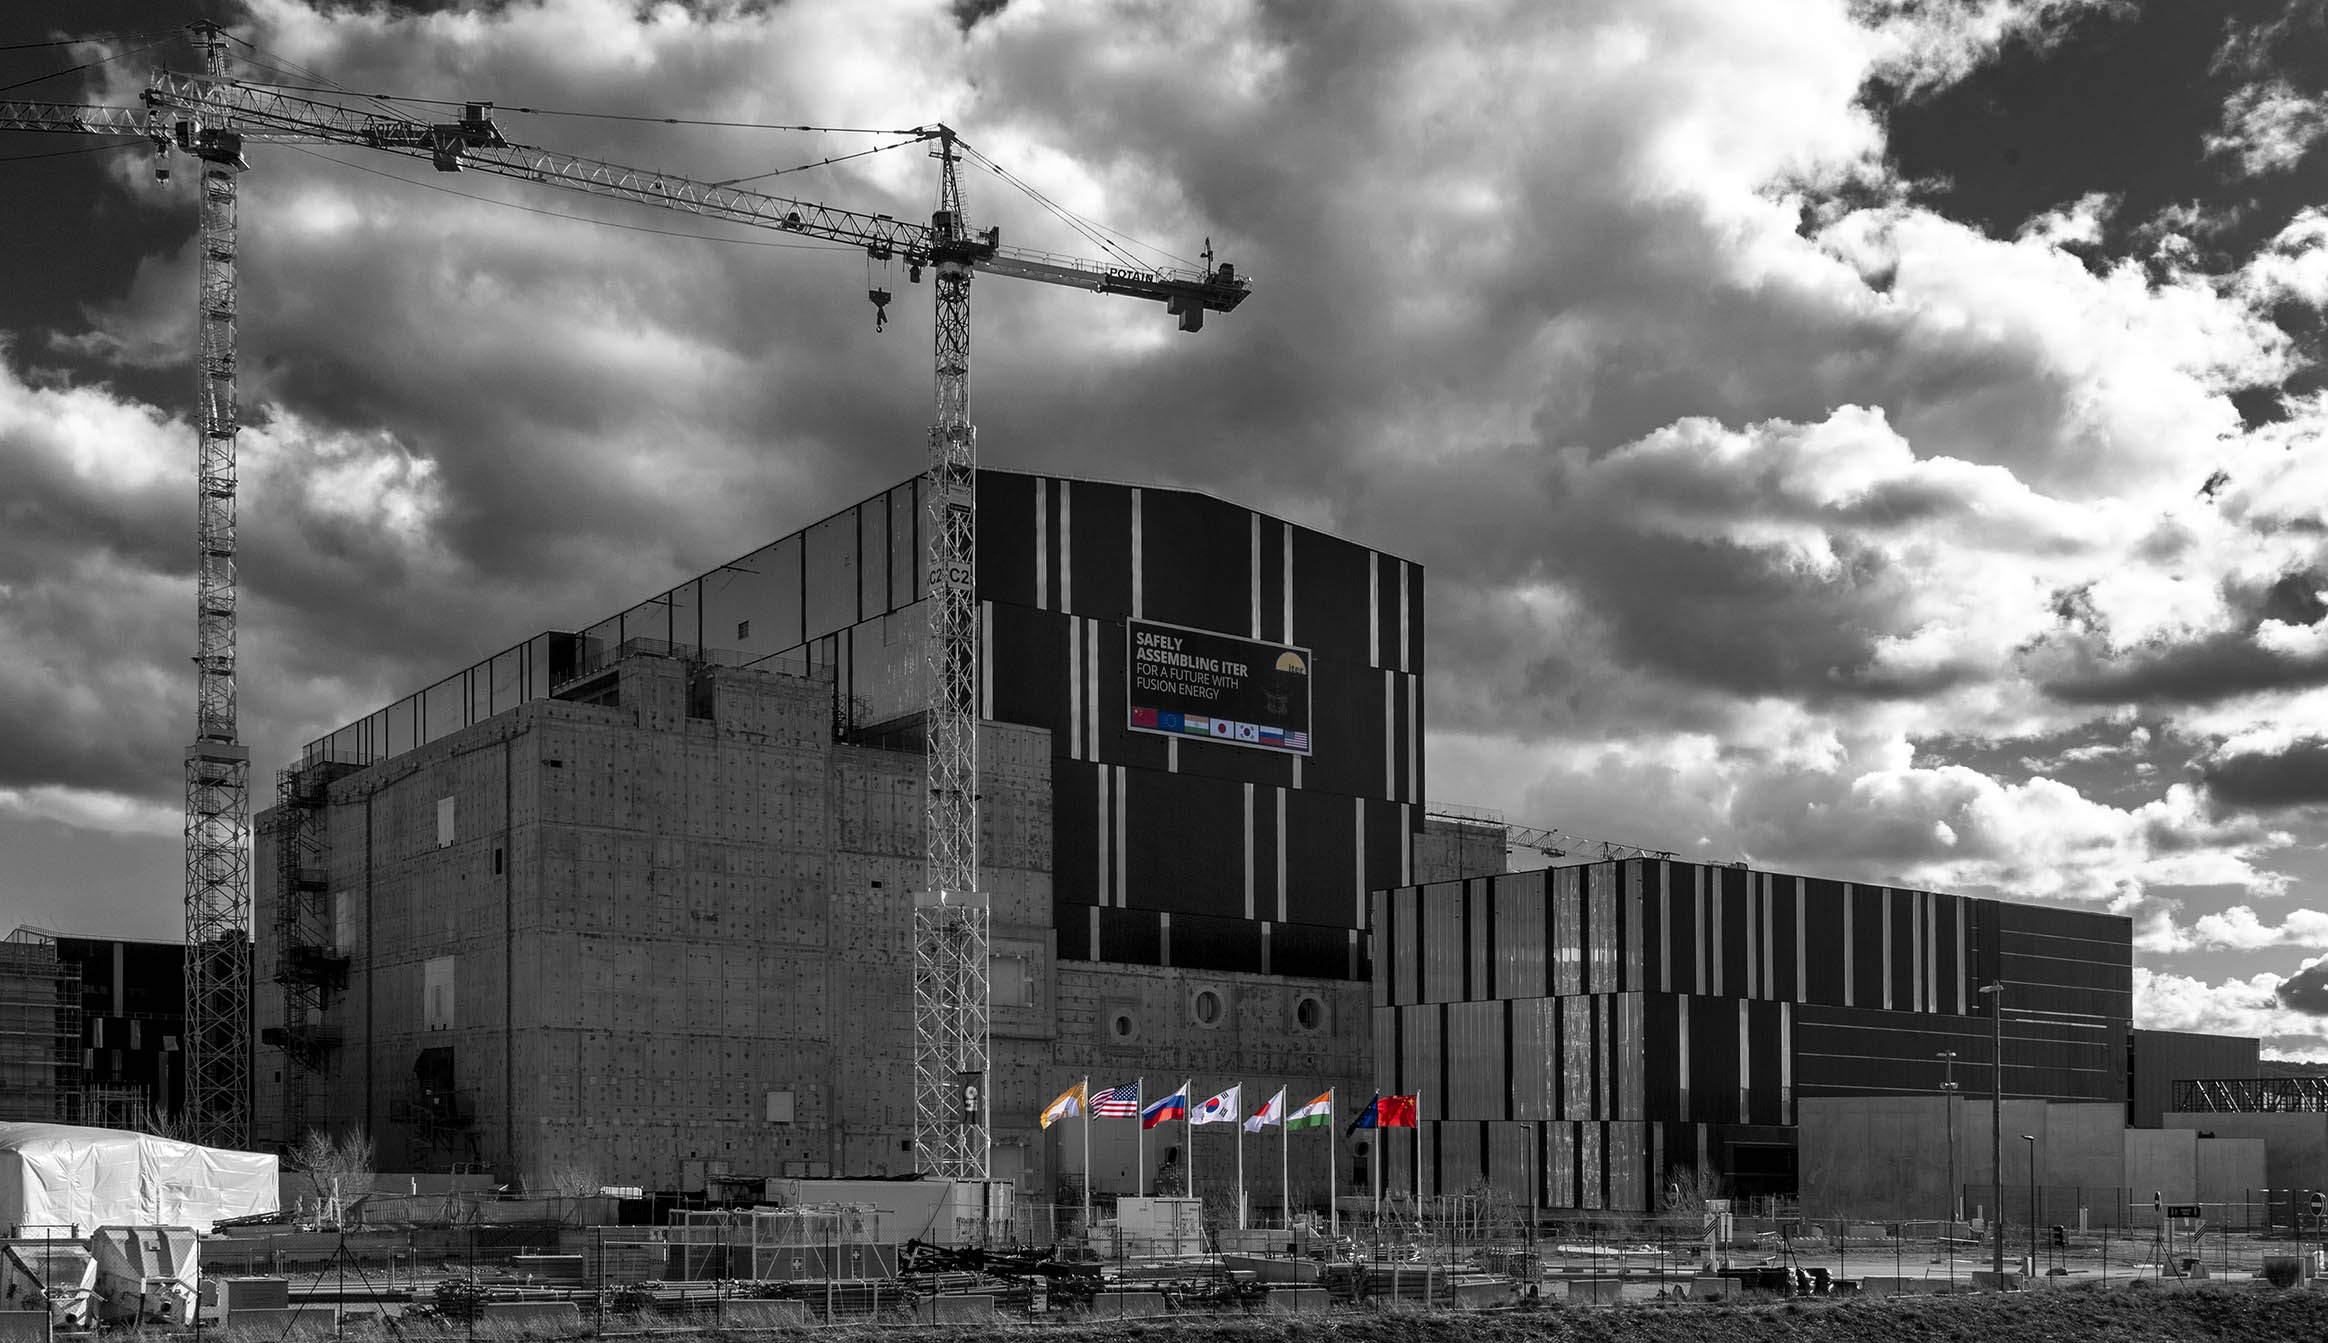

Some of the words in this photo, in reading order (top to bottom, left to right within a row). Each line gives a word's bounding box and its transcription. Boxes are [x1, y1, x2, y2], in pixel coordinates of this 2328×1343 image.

[1110, 267, 1153, 283] POTAIN
[930, 568, 942, 585] C2
[949, 568, 969, 585] C2
[1136, 632, 1183, 651] SAFELY
[1136, 647, 1219, 673] ASSEMBLING
[1222, 661, 1249, 678] ITER
[1288, 663, 1304, 675] iter
[1137, 662, 1158, 677] FOR
[1159, 667, 1168, 678] A
[1170, 668, 1210, 685] FUTURE
[1212, 675, 1239, 689] WITH
[1137, 677, 1176, 694] FUSION
[1179, 683, 1220, 700] ENERGY
